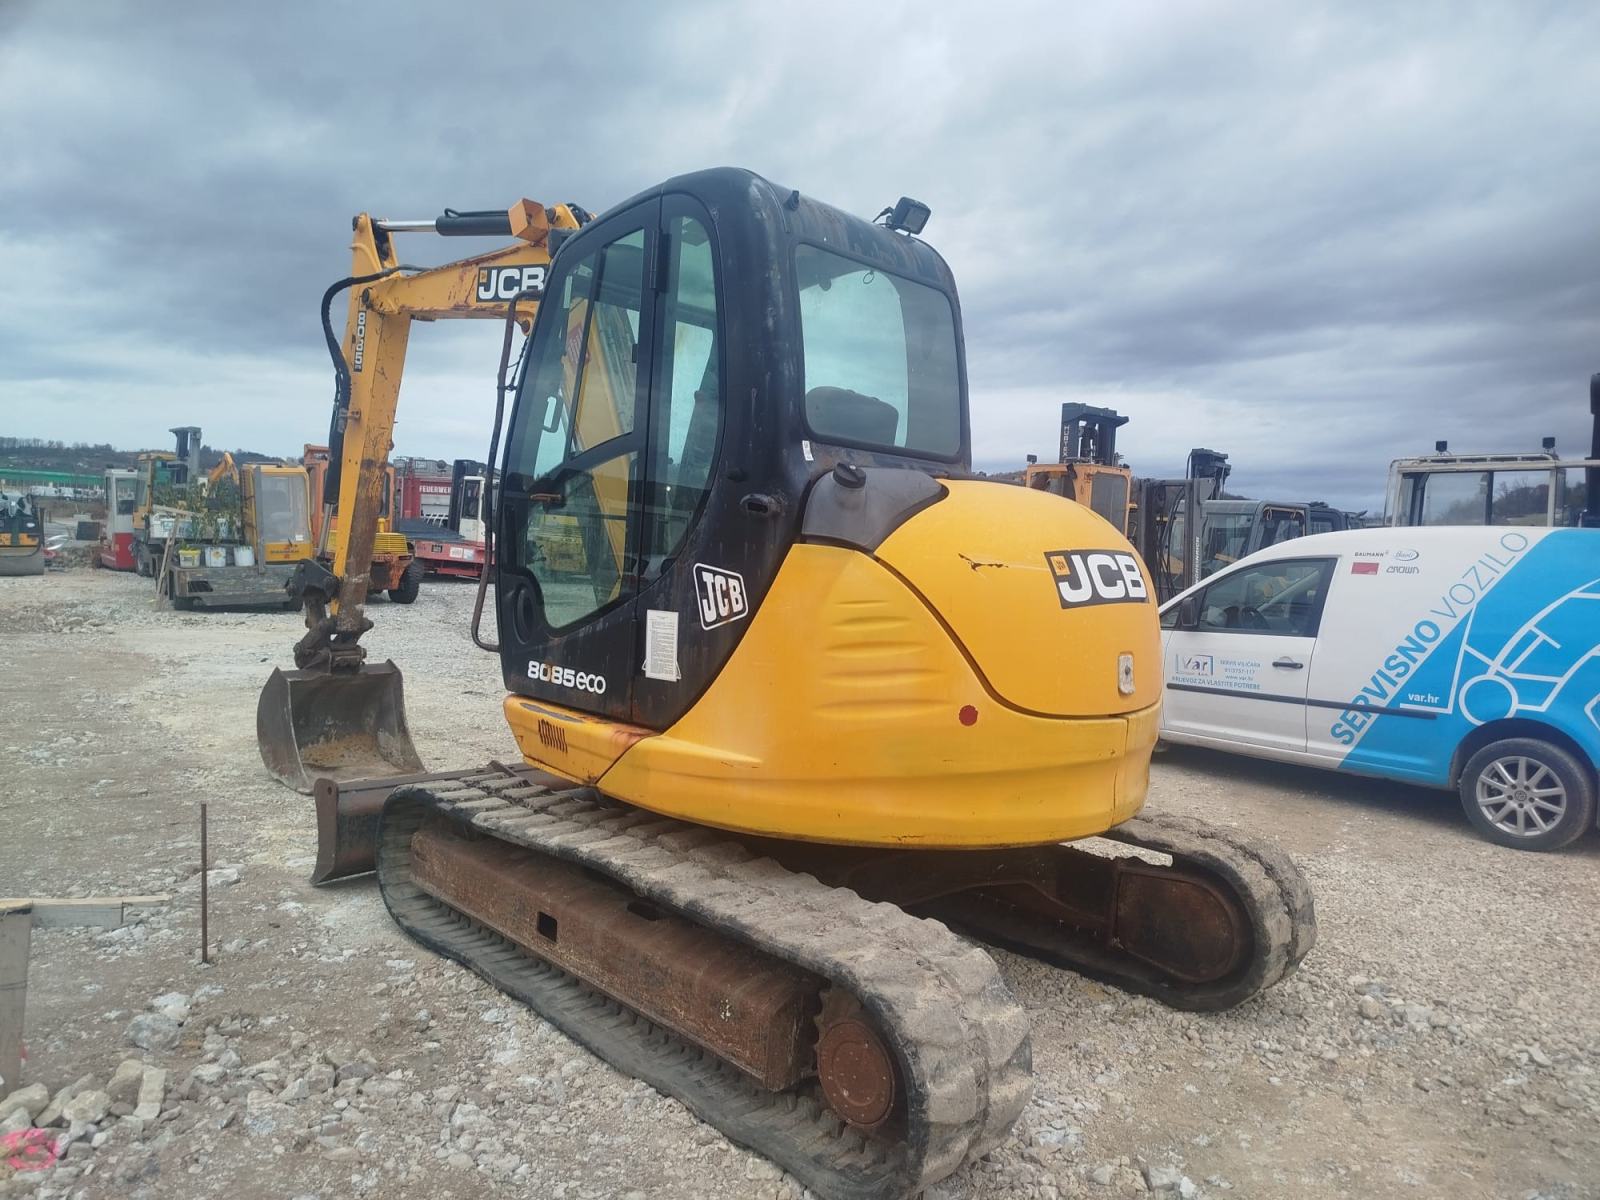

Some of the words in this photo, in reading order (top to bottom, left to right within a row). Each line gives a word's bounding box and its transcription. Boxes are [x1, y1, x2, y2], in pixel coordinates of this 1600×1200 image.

[479, 267, 545, 300] JCB
[701, 571, 744, 622] JCB
[1059, 554, 1147, 603] JCB
[1330, 620, 1441, 745] SERVISNO
[1431, 532, 1528, 619] VOZILO
[1408, 692, 1440, 704] var.hr
